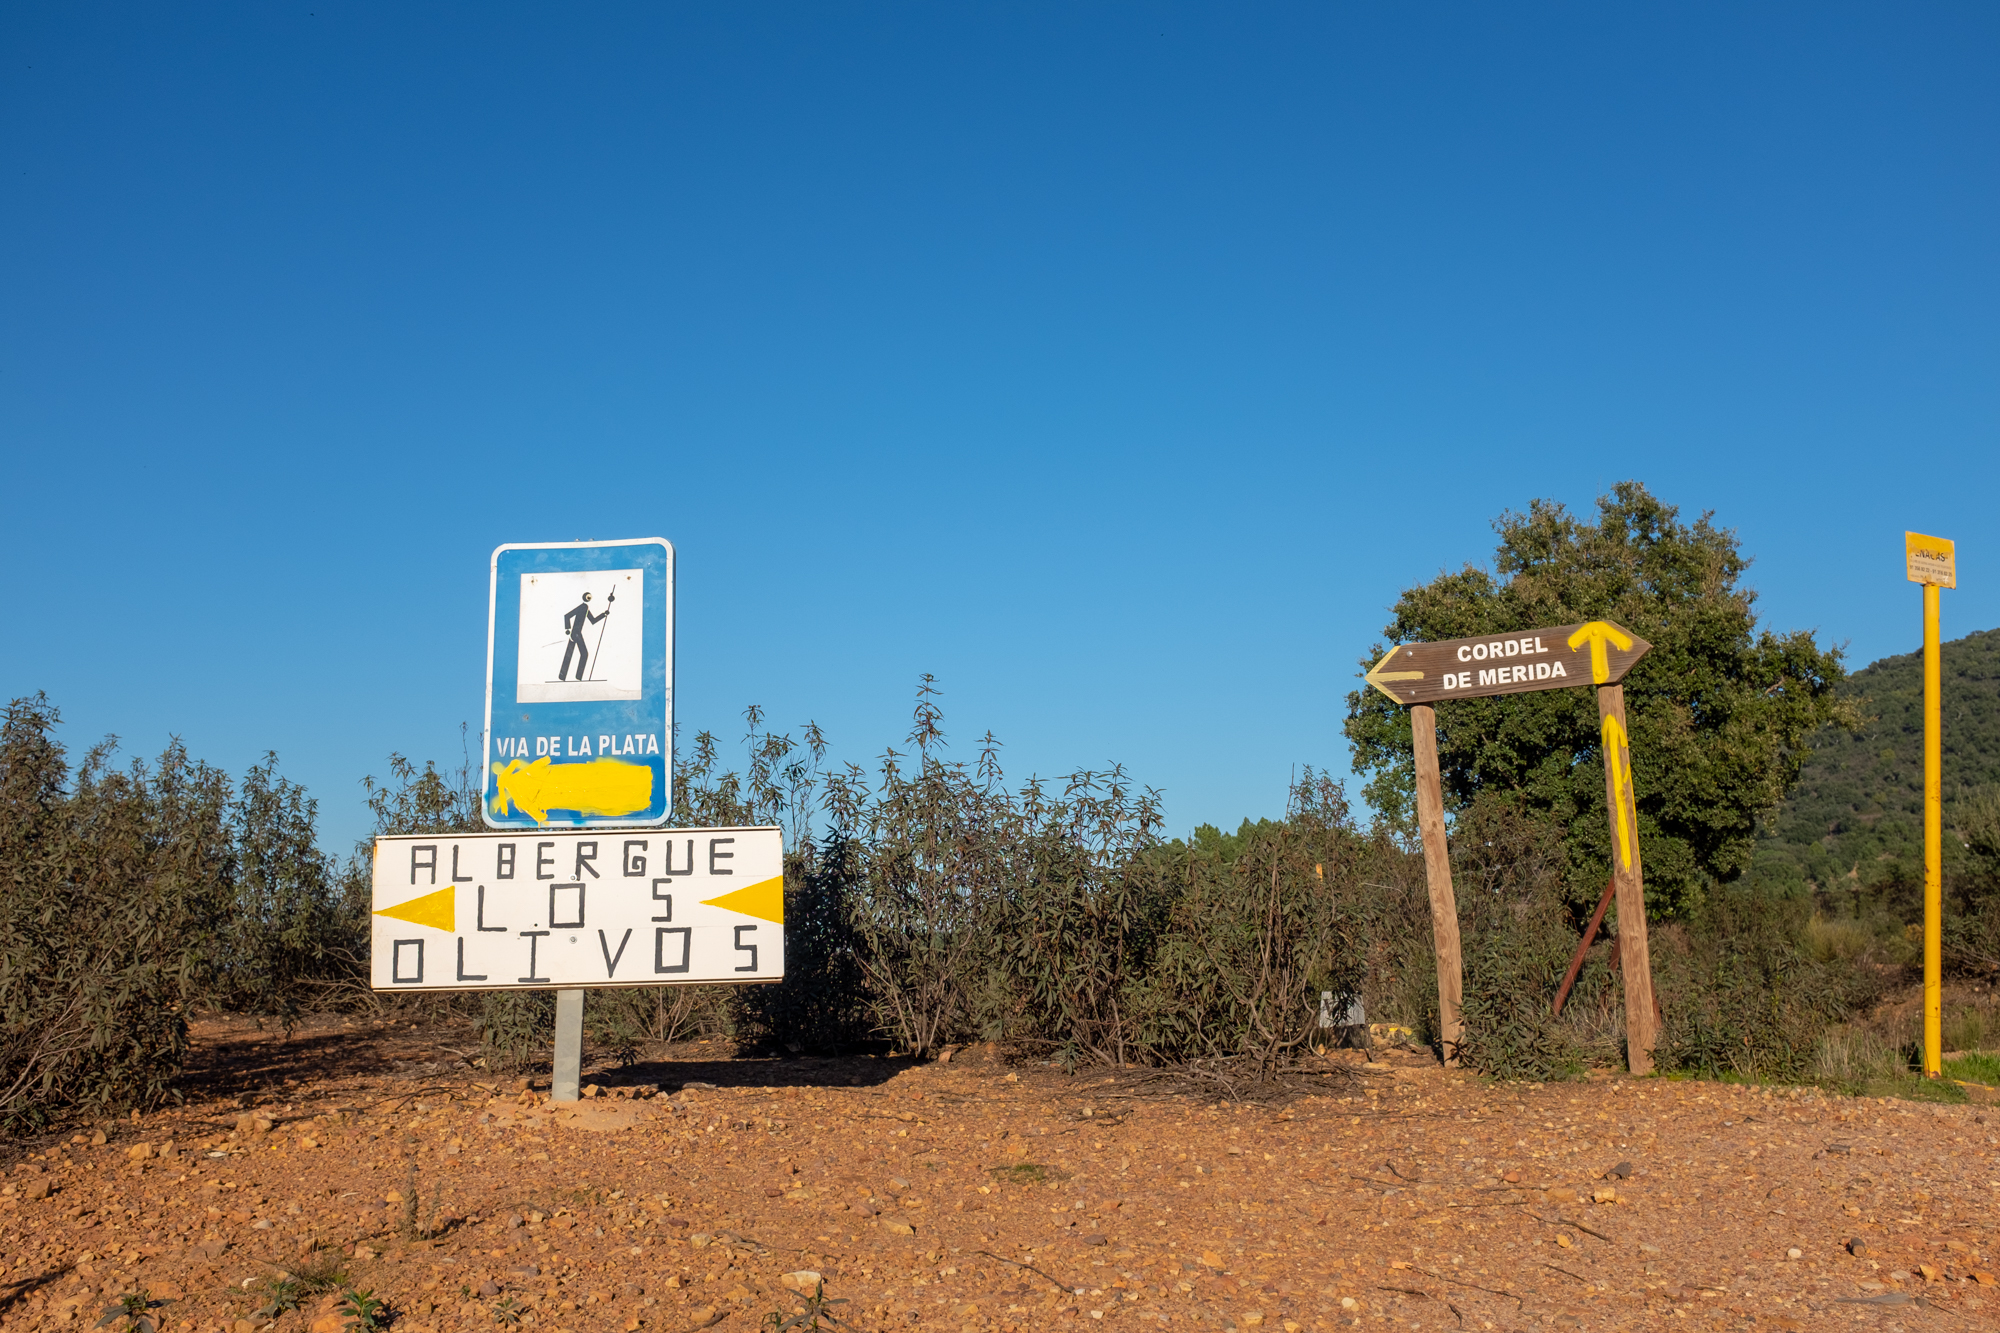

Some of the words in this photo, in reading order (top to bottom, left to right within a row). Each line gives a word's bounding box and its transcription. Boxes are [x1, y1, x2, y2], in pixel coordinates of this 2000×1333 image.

[1457, 636, 1549, 662] CORDEL
[1443, 671, 1472, 690] DE
[1479, 661, 1567, 686] MERIDA
[496, 737, 529, 757] VIA
[536, 736, 561, 756] DE
[568, 735, 592, 756] LA
[599, 734, 659, 755] PLATA
[411, 838, 735, 885] ALBERGUE
[477, 878, 673, 932] LOS
[392, 925, 758, 984] OLIVOS
